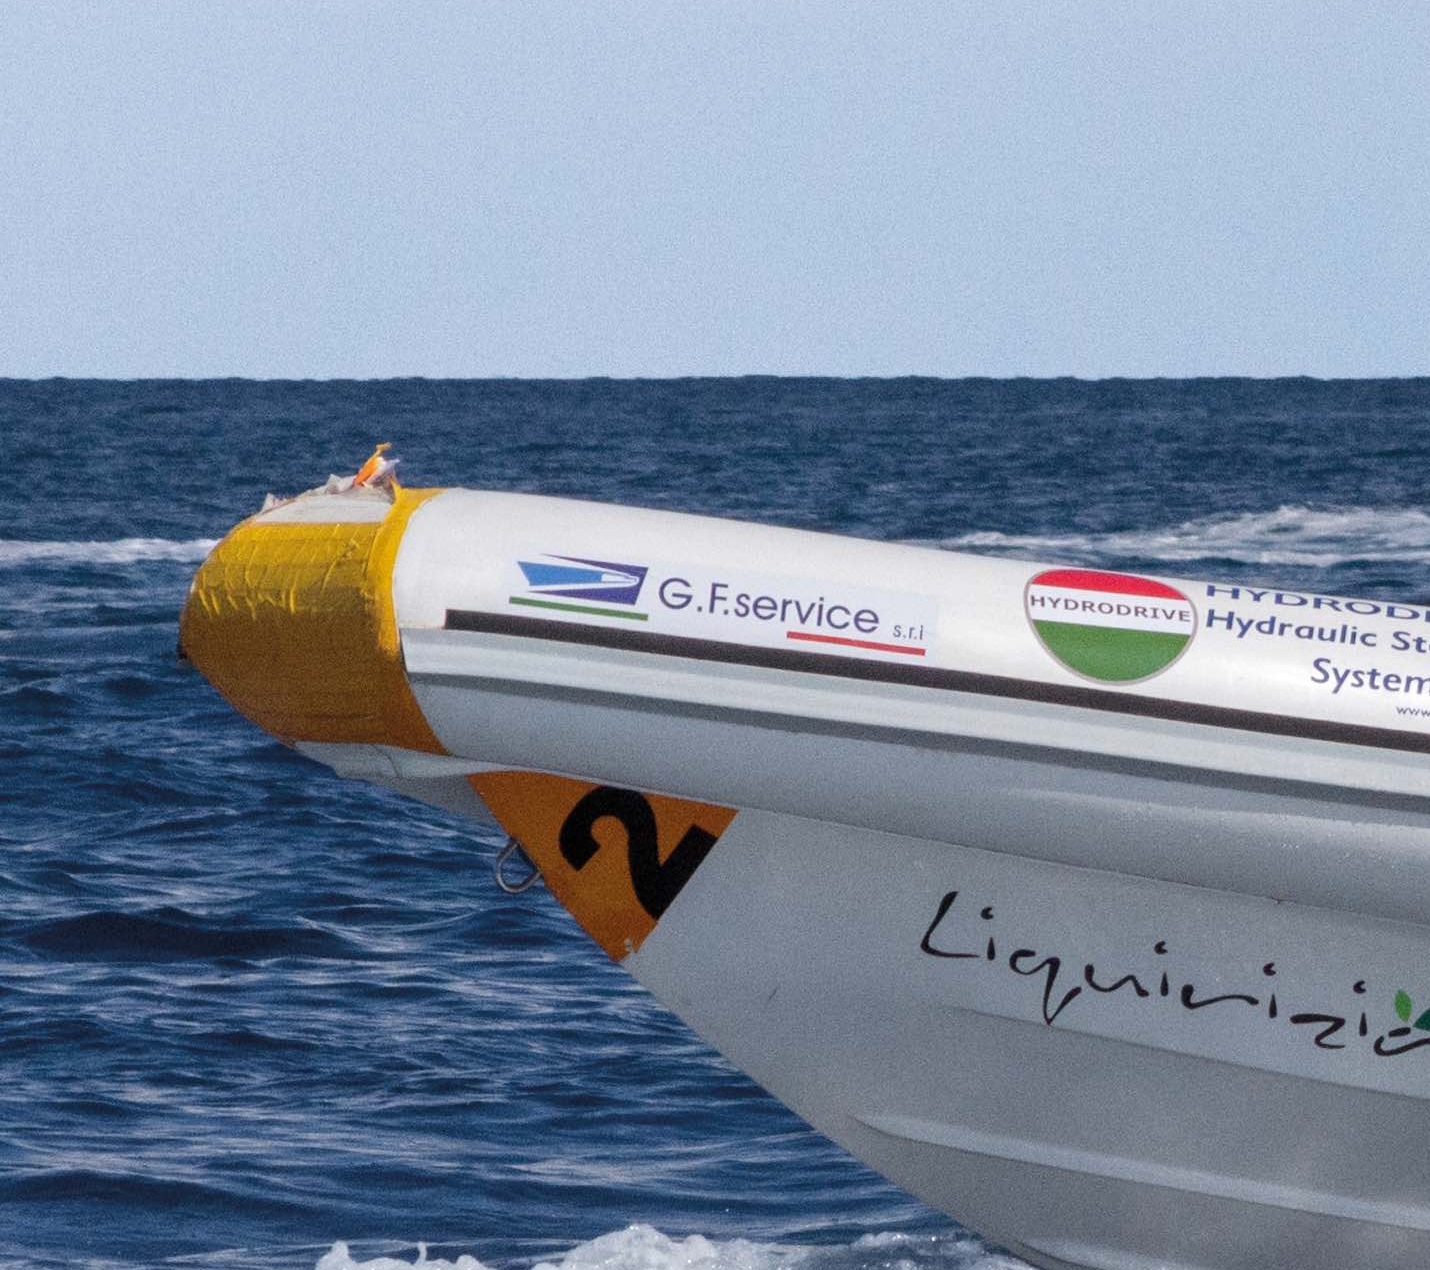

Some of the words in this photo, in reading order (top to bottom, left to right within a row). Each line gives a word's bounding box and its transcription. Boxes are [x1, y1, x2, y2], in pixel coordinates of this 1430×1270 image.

[1029, 594, 1192, 624] HYDRODRIVE
[1206, 607, 1378, 648] Hydraulic
[558, 785, 719, 921] 2
